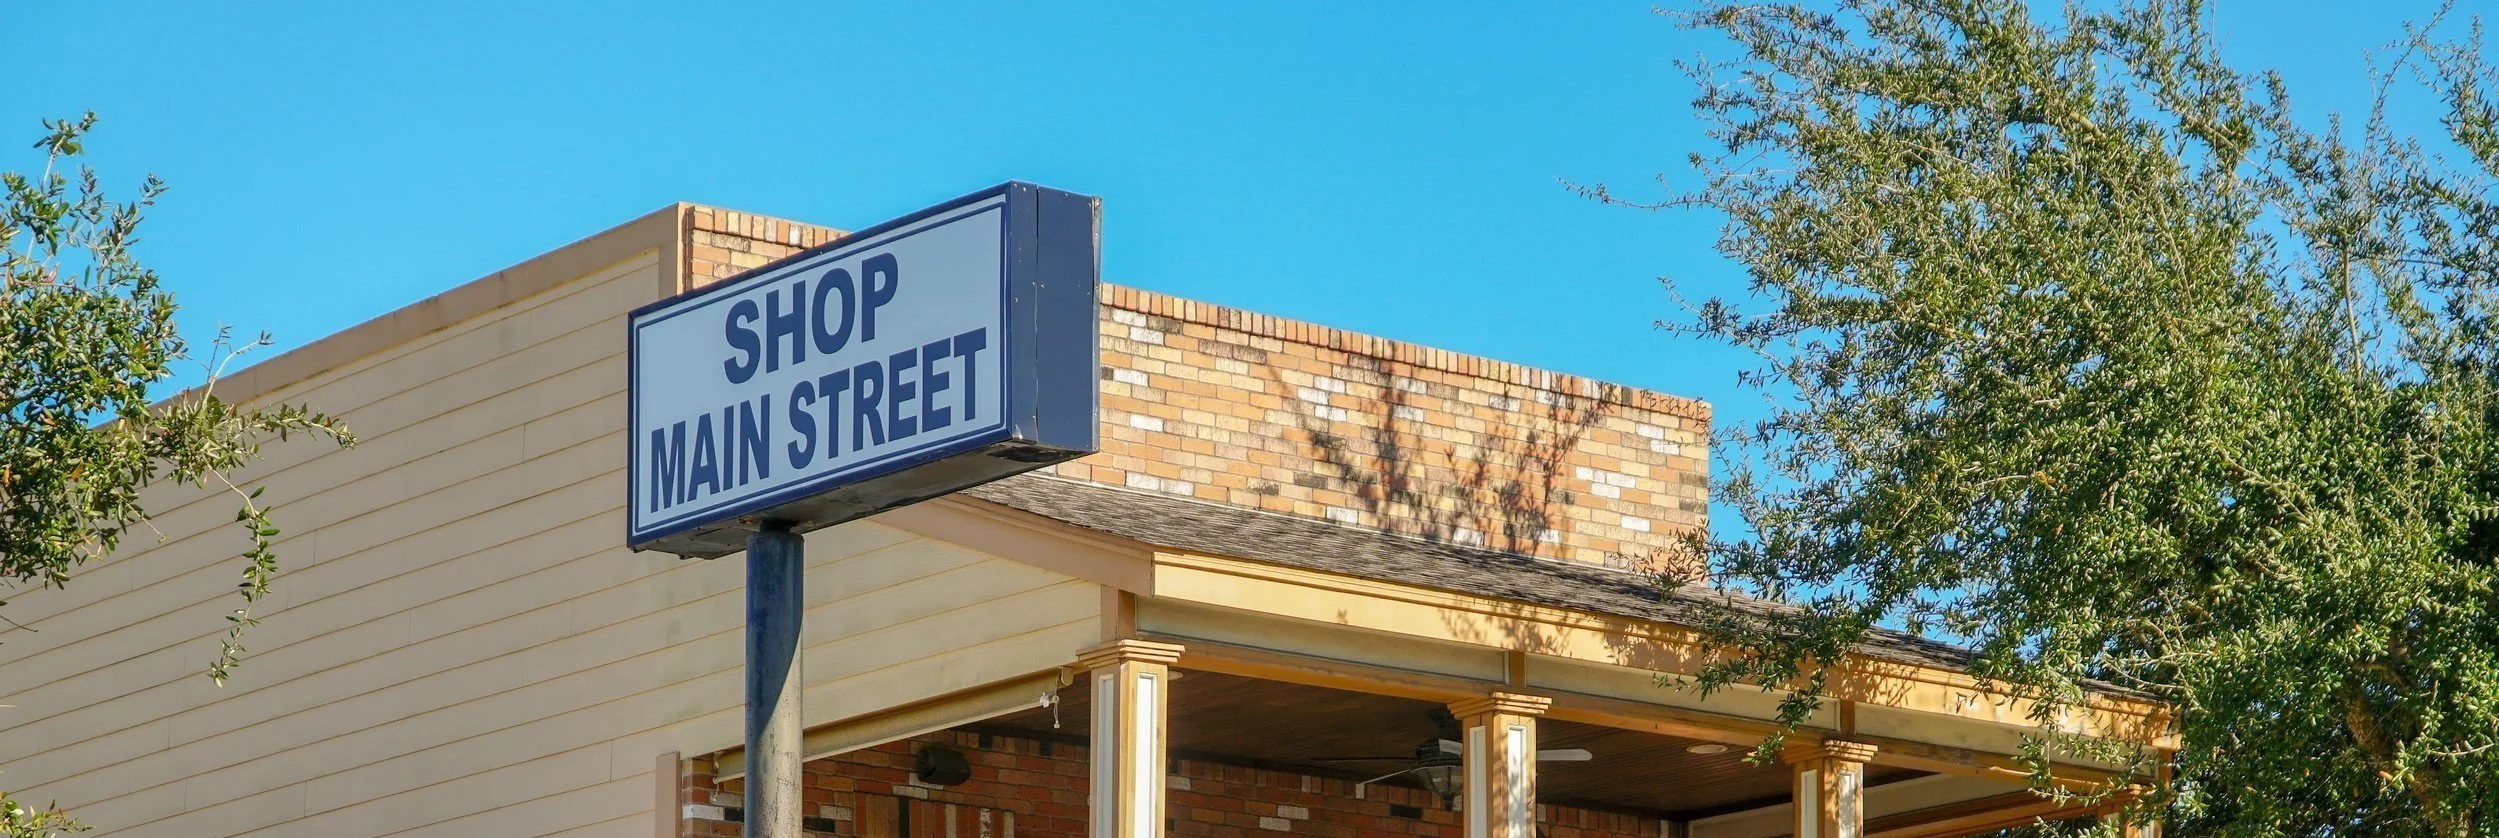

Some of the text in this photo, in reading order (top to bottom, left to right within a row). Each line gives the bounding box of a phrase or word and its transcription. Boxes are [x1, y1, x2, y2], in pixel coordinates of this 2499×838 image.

[723, 252, 899, 385] SHOP
[650, 327, 987, 514] MAIN STREET
